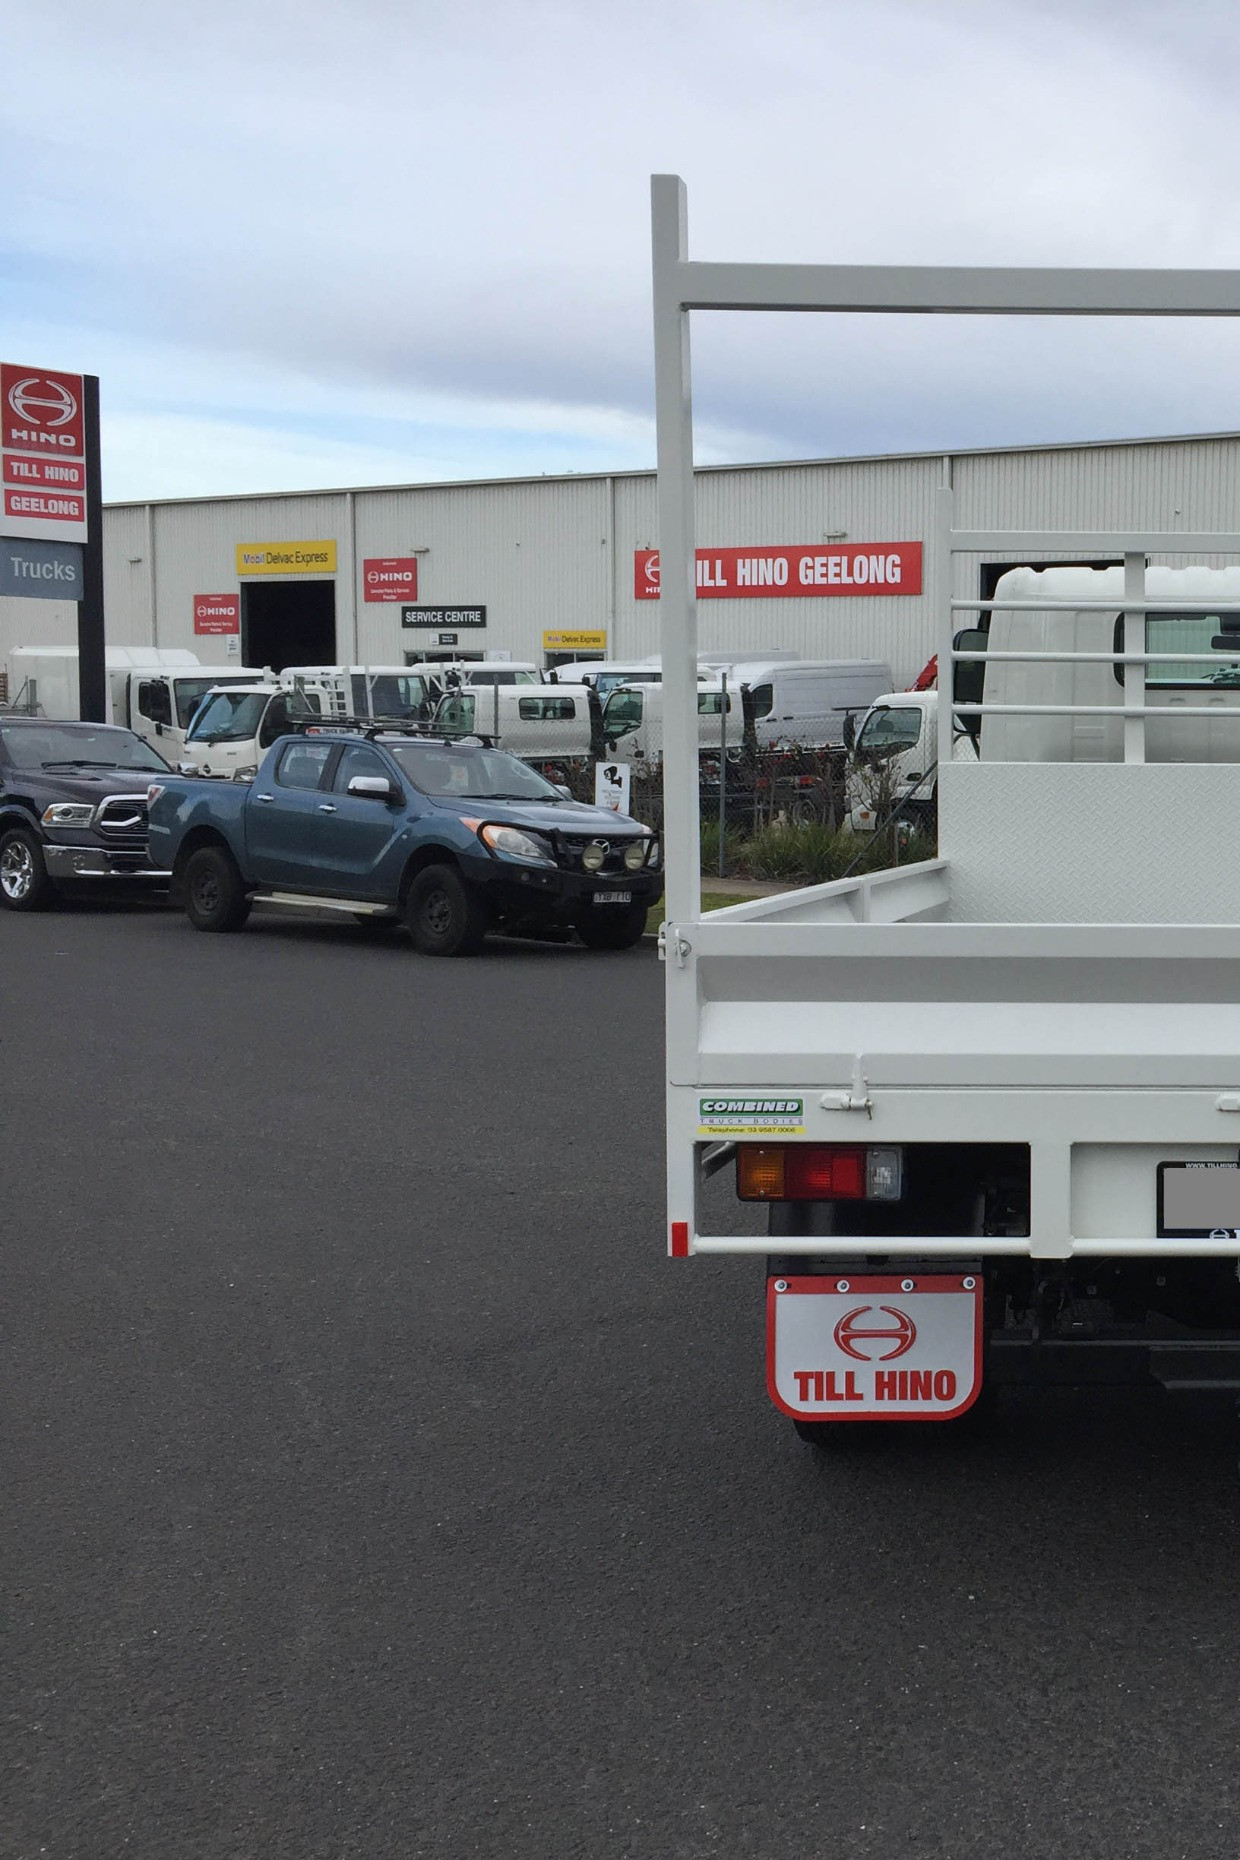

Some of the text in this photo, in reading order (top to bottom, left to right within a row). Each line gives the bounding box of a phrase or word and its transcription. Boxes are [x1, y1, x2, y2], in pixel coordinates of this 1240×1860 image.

[11, 428, 76, 447] HINO
[10, 461, 79, 482] TILL HINO
[10, 495, 79, 515] GEELONG
[243, 551, 329, 567] Mobil Delvac Express
[10, 556, 76, 581] Trucks
[379, 571, 413, 582] HINO
[696, 554, 901, 587] ILL HINO GEELONG
[645, 586, 660, 594] HI
[207, 606, 236, 616] HINO
[405, 610, 482, 623] SERVICE CENTRE
[702, 1101, 800, 1112] COMBINED
[708, 1126, 745, 1134] Telephone:
[793, 1369, 957, 1401] TILL HINO
